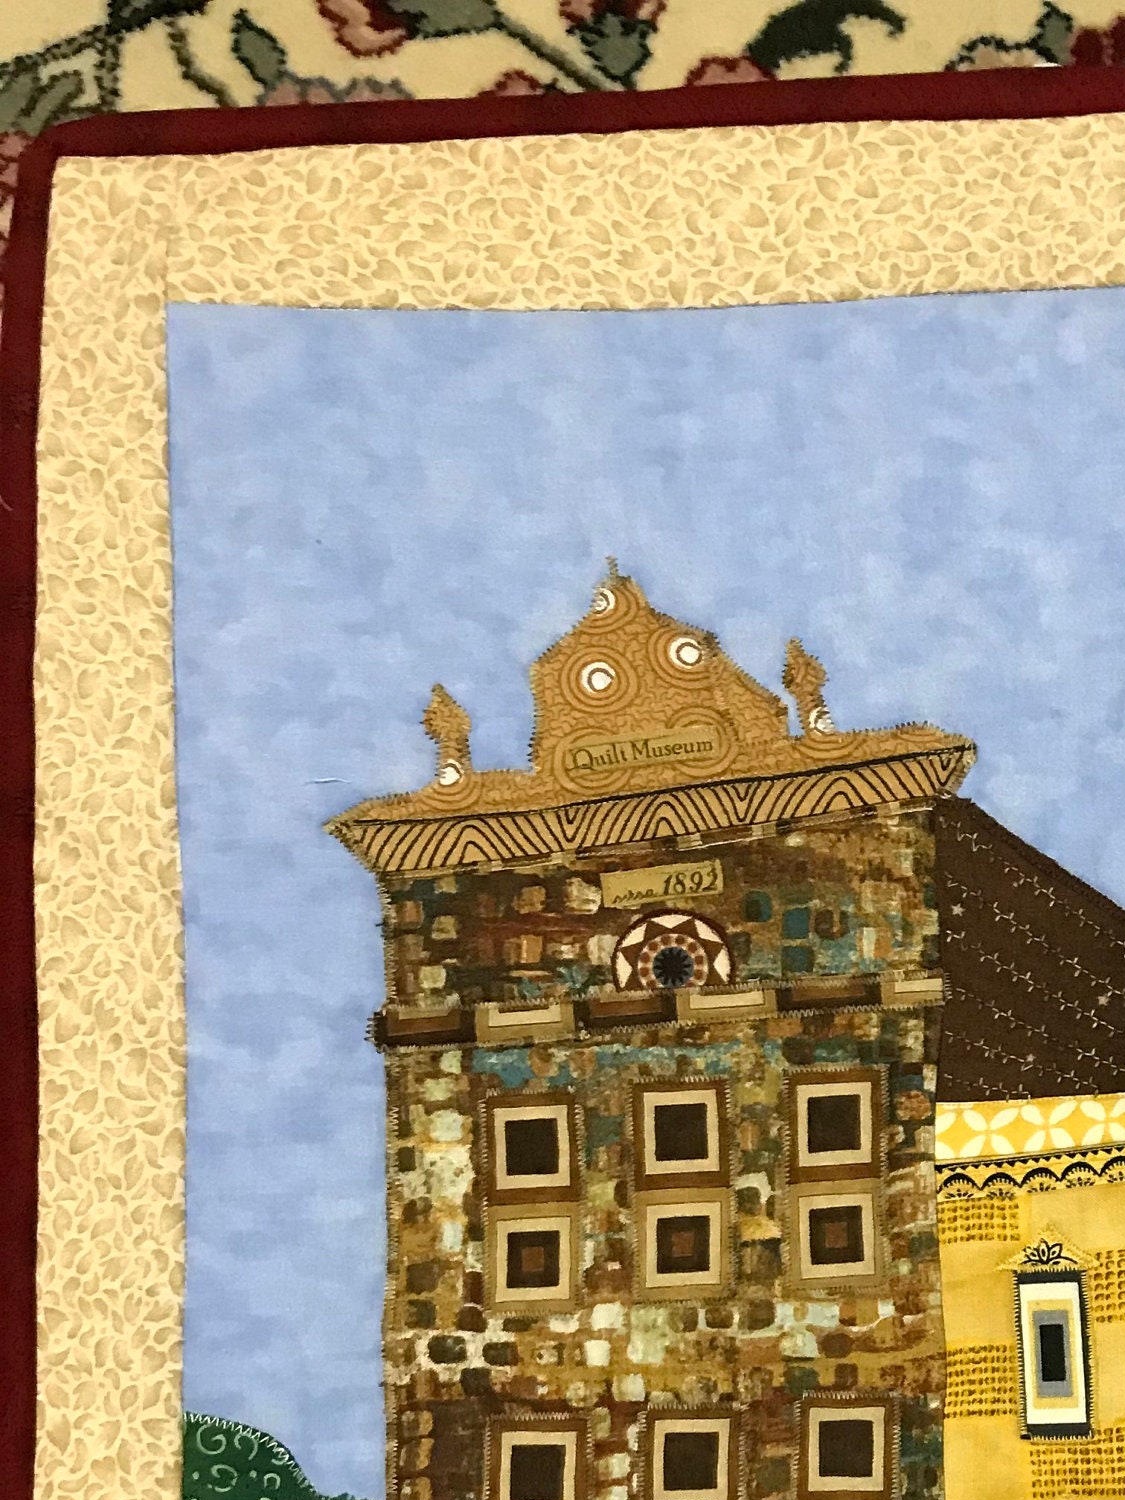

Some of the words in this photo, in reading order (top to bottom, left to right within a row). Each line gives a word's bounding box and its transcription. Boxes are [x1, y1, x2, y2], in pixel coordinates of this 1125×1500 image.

[568, 743, 627, 771] Quilt
[631, 738, 714, 761] Museum
[663, 863, 718, 896] 1892
